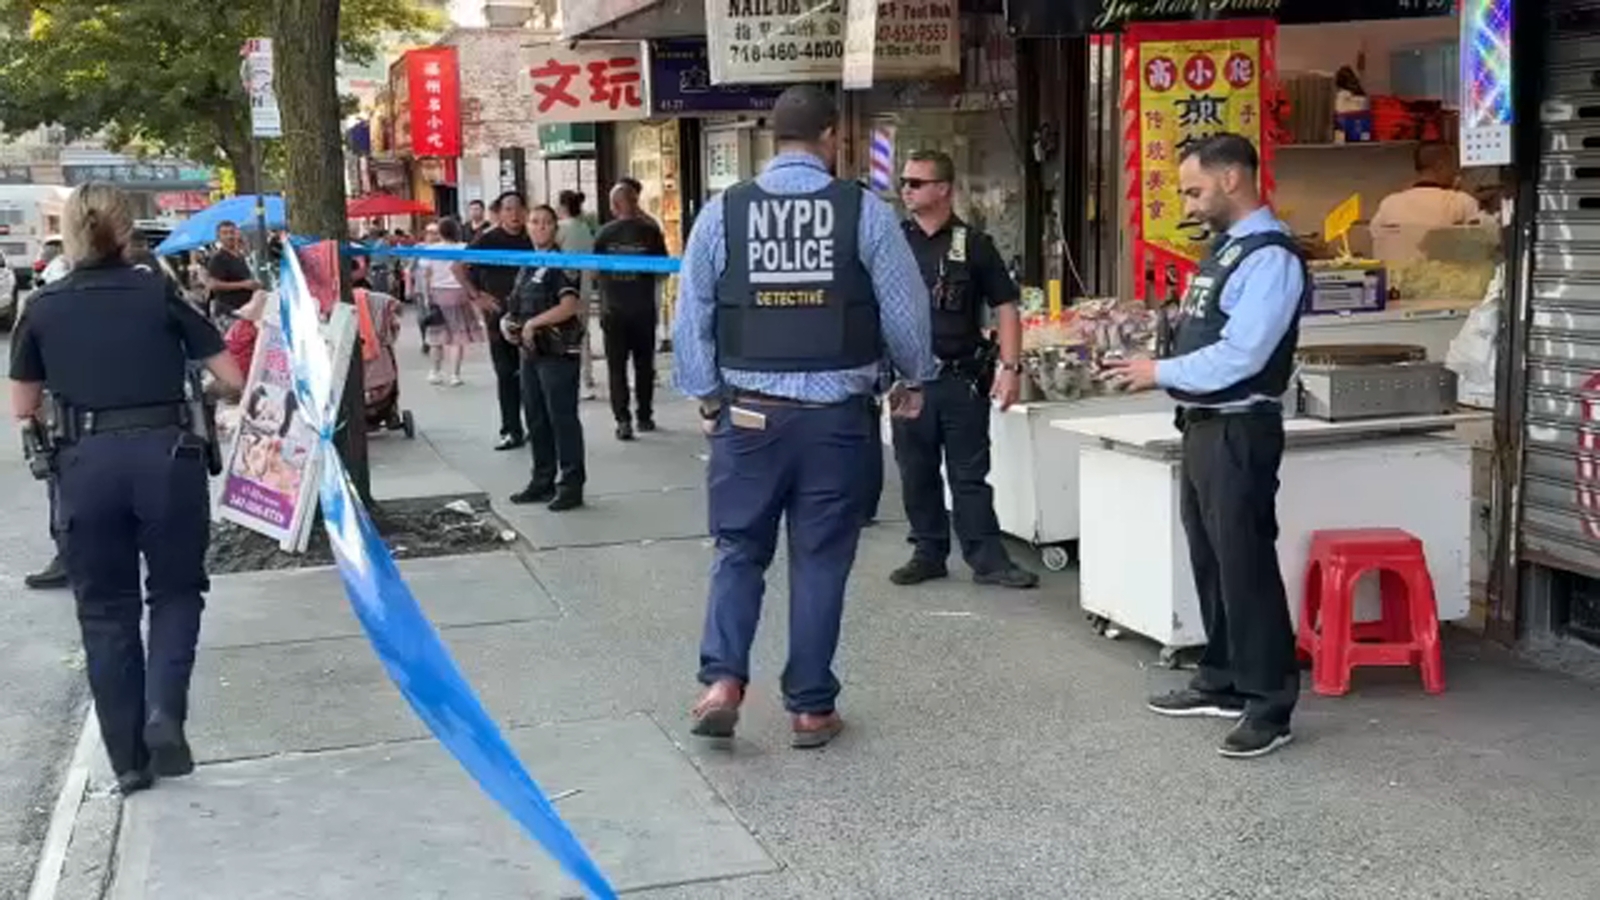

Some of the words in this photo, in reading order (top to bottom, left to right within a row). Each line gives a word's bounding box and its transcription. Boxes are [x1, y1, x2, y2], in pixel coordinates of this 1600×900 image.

[529, 56, 642, 113] 文玩
[748, 199, 834, 239] NYPD
[748, 239, 834, 271] POLICE
[756, 289, 825, 306] DETECTIVE
